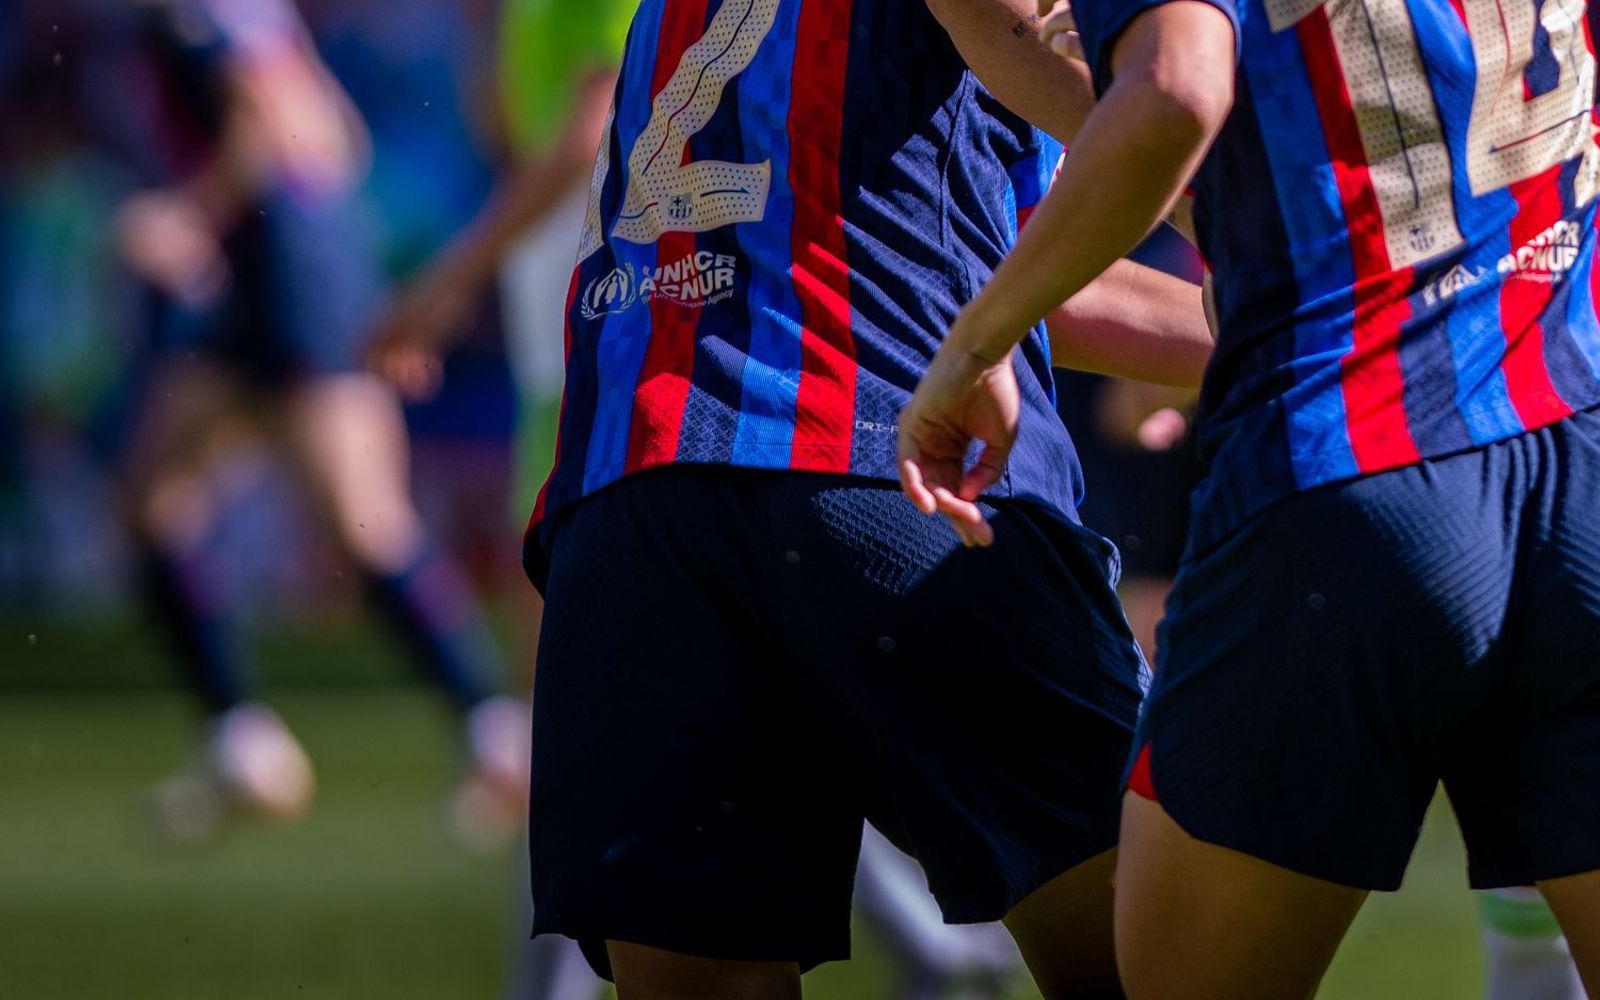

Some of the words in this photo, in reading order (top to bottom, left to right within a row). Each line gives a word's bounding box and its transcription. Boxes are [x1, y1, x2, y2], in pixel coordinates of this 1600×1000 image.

[639, 267, 735, 301] ACNUR
[642, 250, 737, 284] UNHCR
[855, 420, 900, 434] DRI-F
